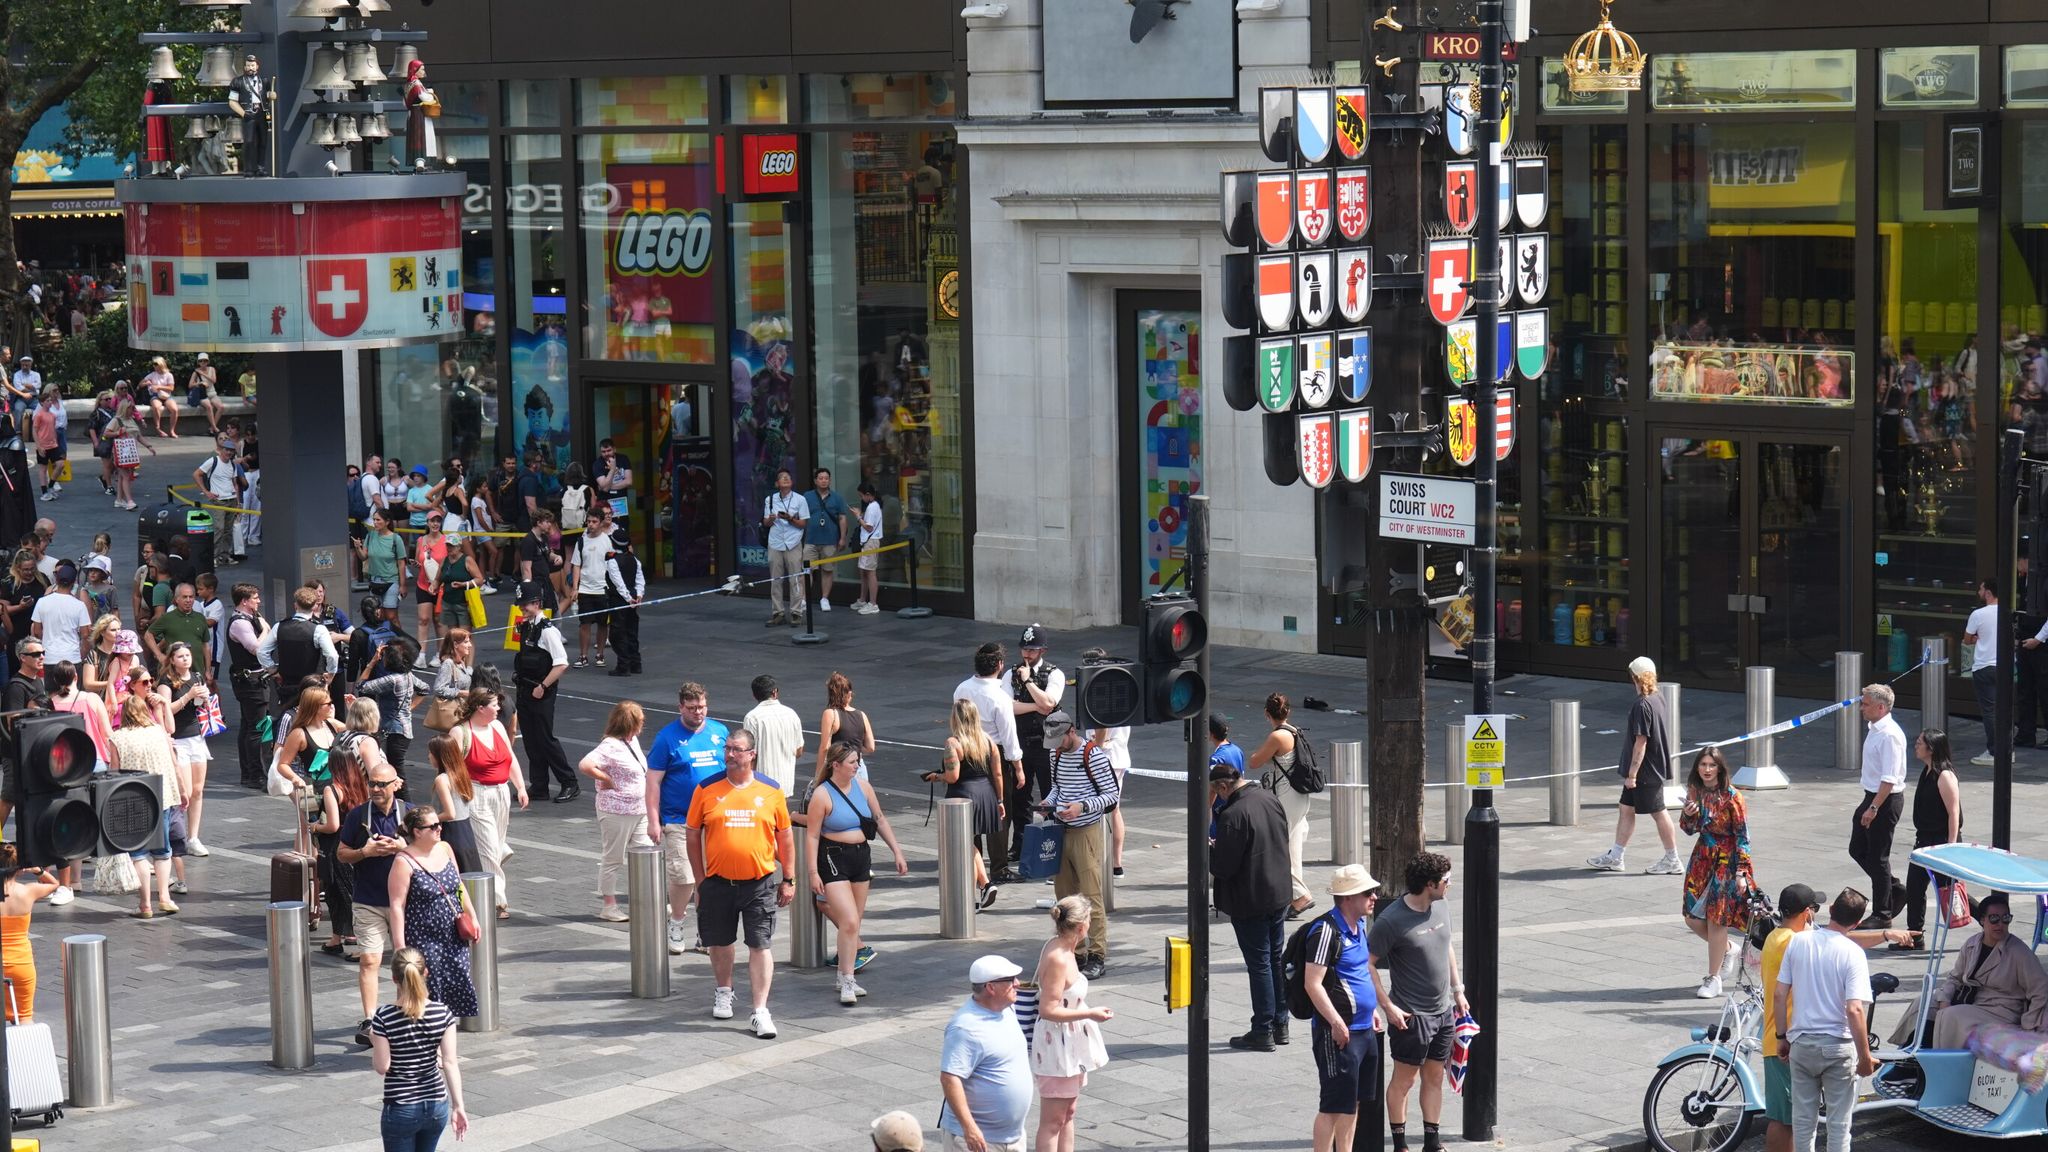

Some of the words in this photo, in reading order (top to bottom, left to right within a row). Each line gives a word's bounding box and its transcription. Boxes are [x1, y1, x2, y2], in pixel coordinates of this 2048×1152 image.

[1739, 79, 1765, 90] TWG
[1916, 75, 1944, 87] TWG
[762, 152, 794, 175] LEGO
[1958, 158, 1974, 169] TWG
[52, 201, 81, 209] COSTA
[85, 200, 120, 208] COFFEE
[617, 214, 711, 271] LEGO
[362, 328, 396, 336] Switzerland
[1390, 481, 1426, 498] SWISS
[1389, 499, 1426, 516] COURT
[1430, 502, 1455, 519] WC2
[1389, 522, 1404, 532] CITY
[1406, 524, 1415, 533] OF
[1417, 525, 1466, 538] WESTMINSTER
[725, 809, 756, 817] UNIBET
[1977, 1075, 1995, 1086] GLOW
[1987, 1087, 2002, 1098] TAXI
